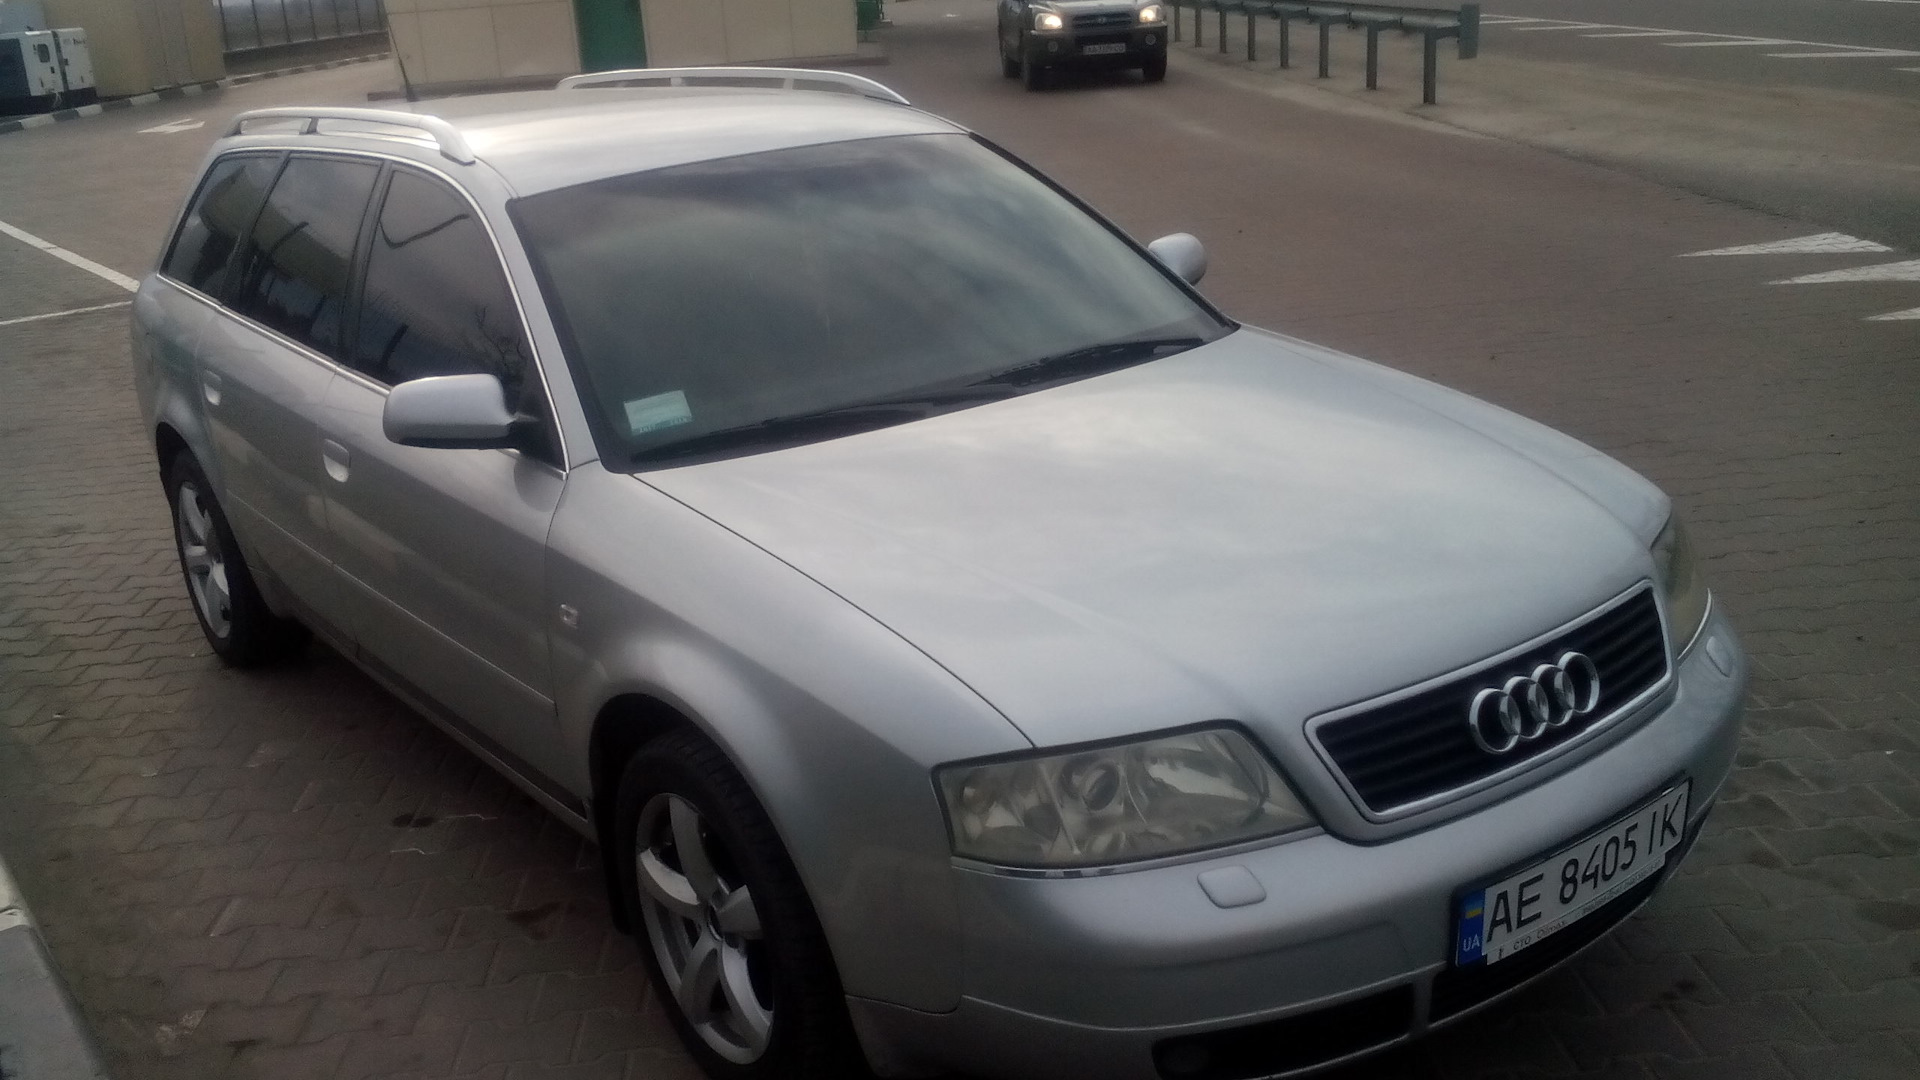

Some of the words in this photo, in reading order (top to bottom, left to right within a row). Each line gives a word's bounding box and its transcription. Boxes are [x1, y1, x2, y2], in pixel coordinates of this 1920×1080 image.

[1487, 874, 1543, 942] AE
[1559, 823, 1638, 904] 8405
[1648, 794, 1682, 855] IK
[1463, 934, 1480, 951] UA
